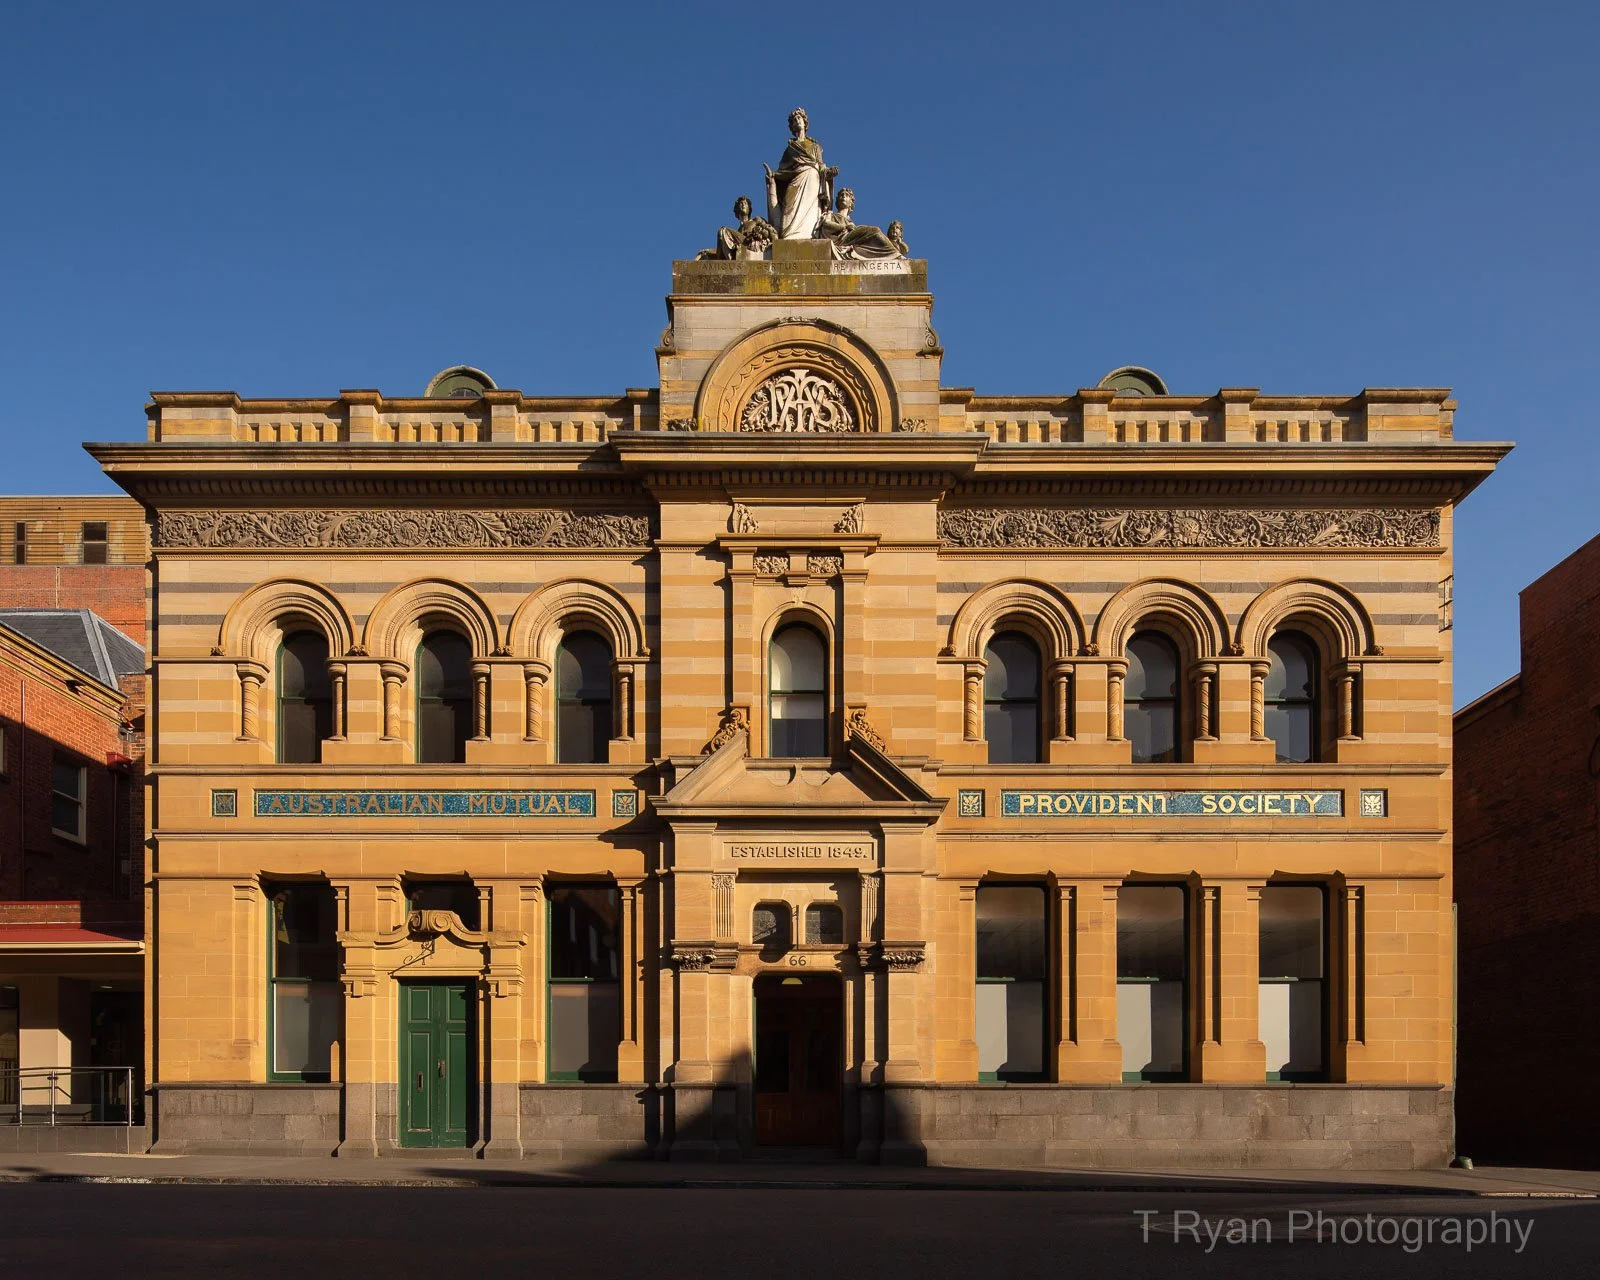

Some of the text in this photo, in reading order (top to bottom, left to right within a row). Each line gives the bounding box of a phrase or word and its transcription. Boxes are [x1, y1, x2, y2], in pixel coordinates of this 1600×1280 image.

[269, 794, 581, 814] AUSTRALIAN MUTUAL
[1019, 794, 1324, 814] PROVIDENT SOCIETY
[731, 846, 822, 858] ESTABLISHED
[789, 955, 807, 967] 66
